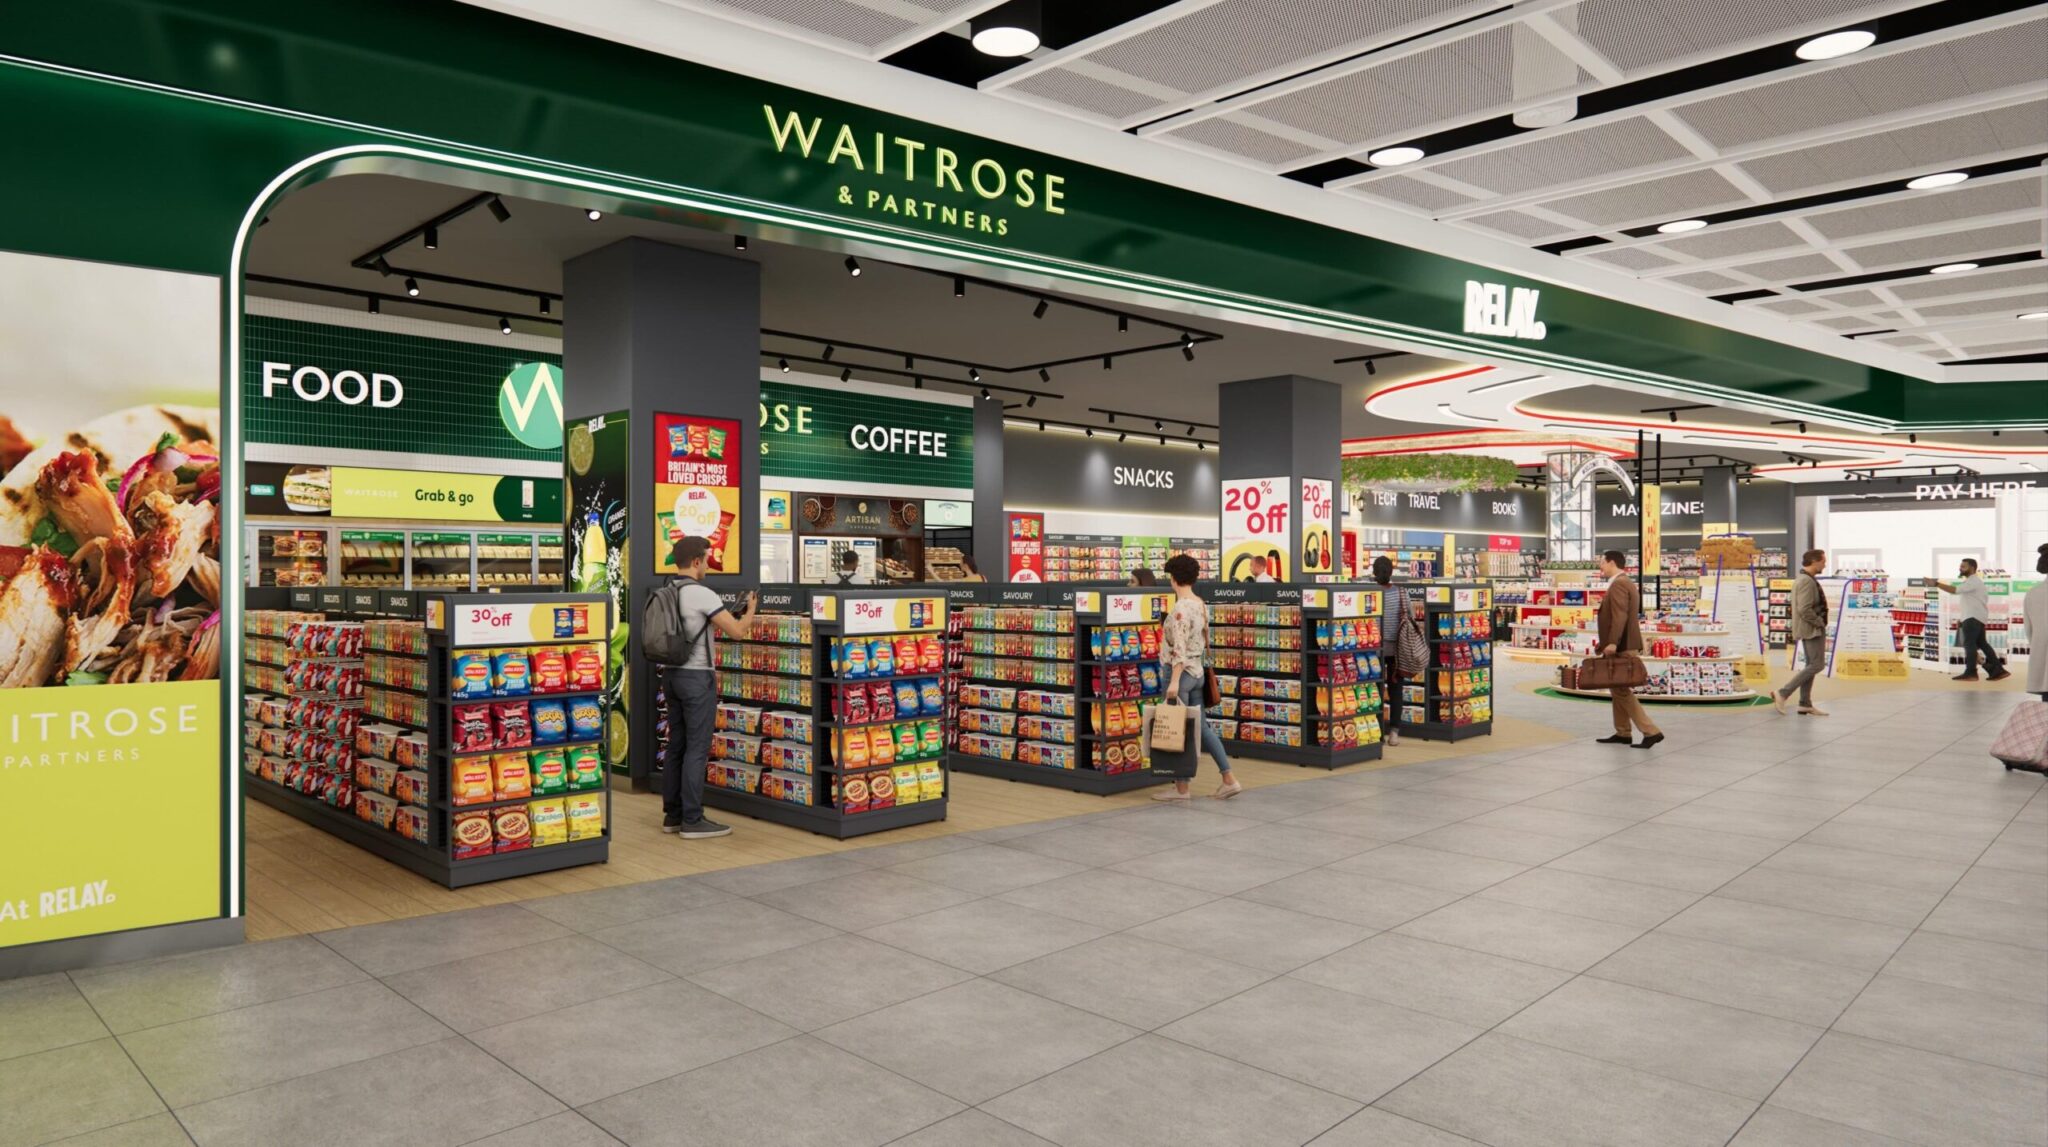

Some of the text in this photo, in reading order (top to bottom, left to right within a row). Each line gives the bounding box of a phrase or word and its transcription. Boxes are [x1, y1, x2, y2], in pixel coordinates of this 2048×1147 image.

[764, 104, 1065, 215] WAITROSE
[838, 185, 1008, 235] & PARTNERS
[261, 360, 404, 409] FOOD
[850, 424, 948, 458] COFFEE
[668, 460, 727, 475] BRITAIN'S MOST
[667, 471, 728, 486] LOVED CRISPS
[1113, 466, 1174, 489] SNACKS
[415, 488, 474, 506] Grab & go
[1916, 480, 2037, 500] PAY HERE
[1313, 499, 1331, 519] off
[1373, 493, 1441, 510] TECH TRAVEL
[1492, 502, 1517, 516] BOOKS
[1612, 501, 1704, 516] MAZINE
[607, 507, 627, 525] ORANGE
[845, 515, 881, 525] ARTISAN
[1246, 503, 1289, 534] off
[610, 520, 625, 534] JUICE
[355, 595, 371, 605] SNACKS
[717, 593, 736, 602] NACKS
[763, 595, 791, 604] SAVOURY
[950, 590, 974, 599] SNACKS
[1003, 592, 1033, 600] SAVOURY
[1214, 589, 1246, 597] SAVOURY
[390, 597, 408, 607] SNACKS
[491, 612, 512, 627] off
[868, 606, 882, 619] off
[5, 748, 140, 769] PARTNERS
[0, 900, 30, 922] At
